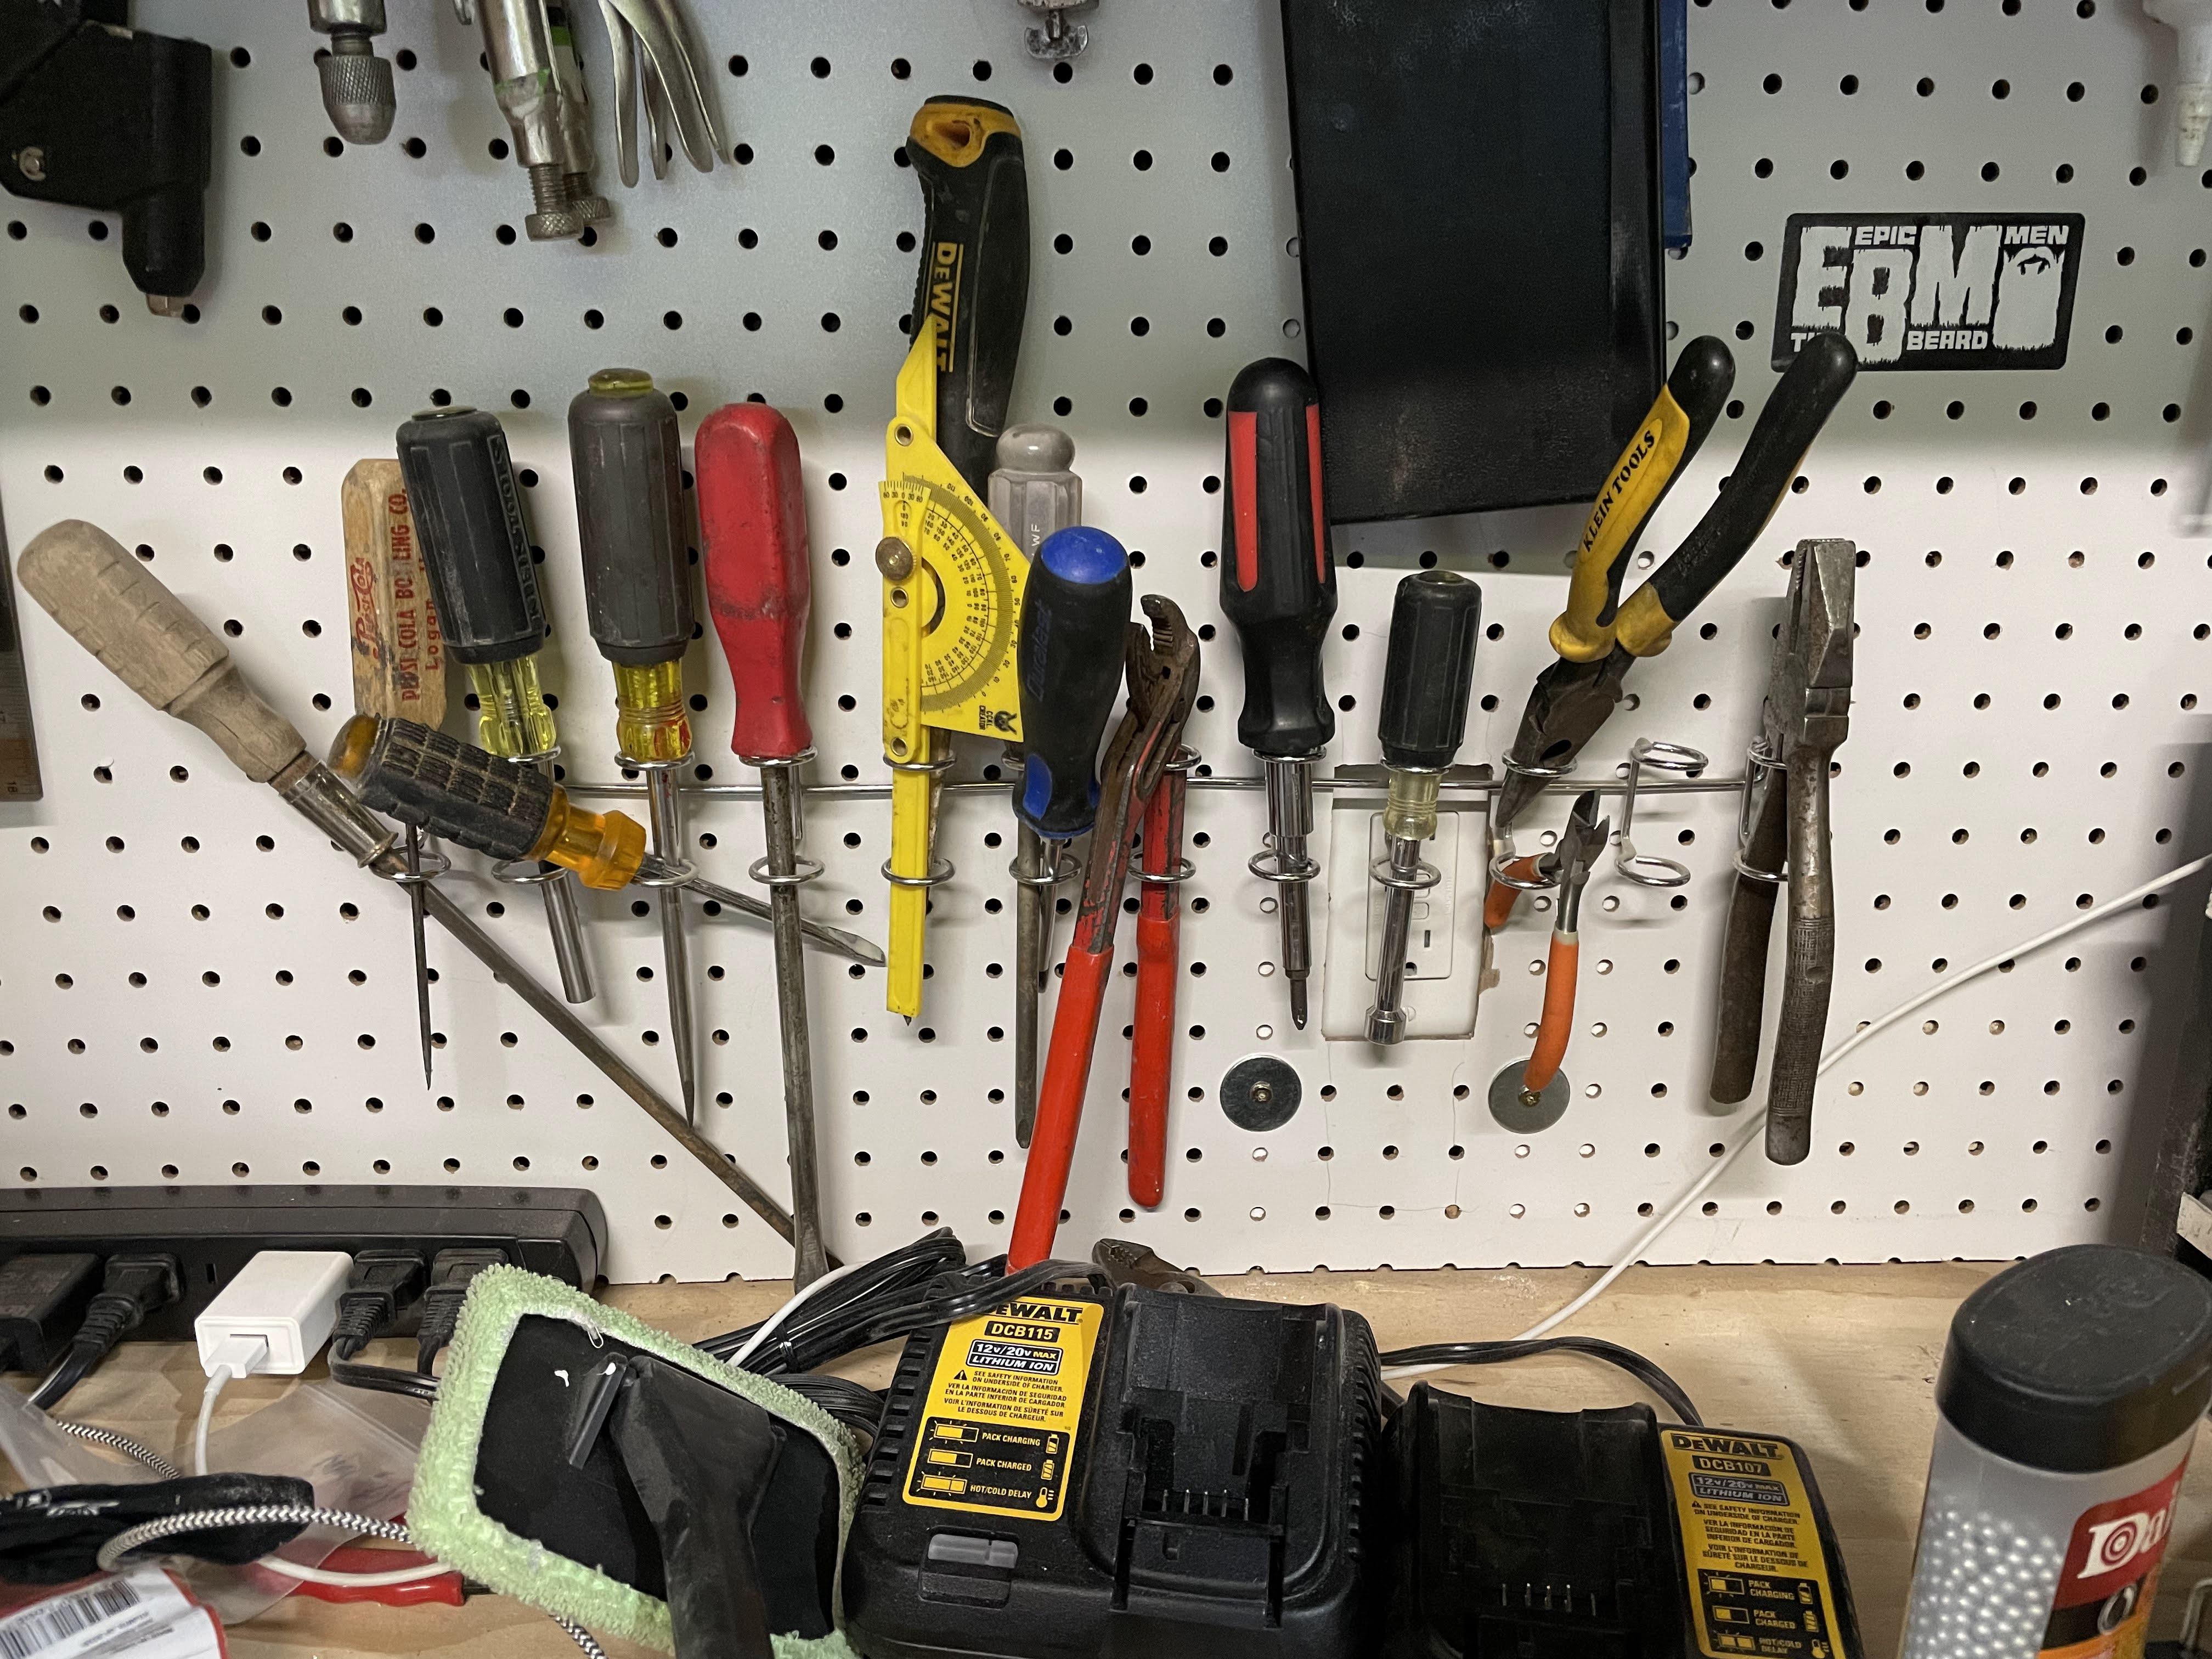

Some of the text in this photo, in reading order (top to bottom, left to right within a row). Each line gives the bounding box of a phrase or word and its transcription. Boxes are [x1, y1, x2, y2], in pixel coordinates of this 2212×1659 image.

[1855, 226, 2069, 245] EPIC MEN
[1906, 330, 1988, 350] BEARD
[1583, 430, 1654, 552] KLEIN TOOLS
[388, 488, 408, 515] CO.
[390, 524, 415, 599] BOLING
[397, 609, 417, 648] COLA
[425, 599, 442, 670] Logan
[991, 1323, 1053, 1340] DCB115
[972, 1356, 1054, 1371] LITHIUM ION
[983, 1378, 1020, 1387] UNDERSIDE
[1013, 1375, 1058, 1385] INFORMATION
[987, 1393, 1017, 1402] INFERIOR
[1029, 1392, 1066, 1401] SEGURIDAD
[961, 1400, 1012, 1410] L'INFORMATION
[966, 1407, 997, 1416] DESSOUS
[981, 1432, 1040, 1446] PACK CHARGING
[976, 1458, 1031, 1471] PACK CHARGED
[1699, 1458, 1761, 1472] DCB107
[970, 1485, 1031, 1498] HOT/COLD DELAY
[1700, 1487, 1781, 1502] LITHIUM ION
[1748, 1579, 1770, 1589] PACK
[1750, 1588, 1794, 1600] CHARGING
[1753, 1609, 1775, 1618] PACK
[1755, 1618, 1795, 1629] CHARGED
